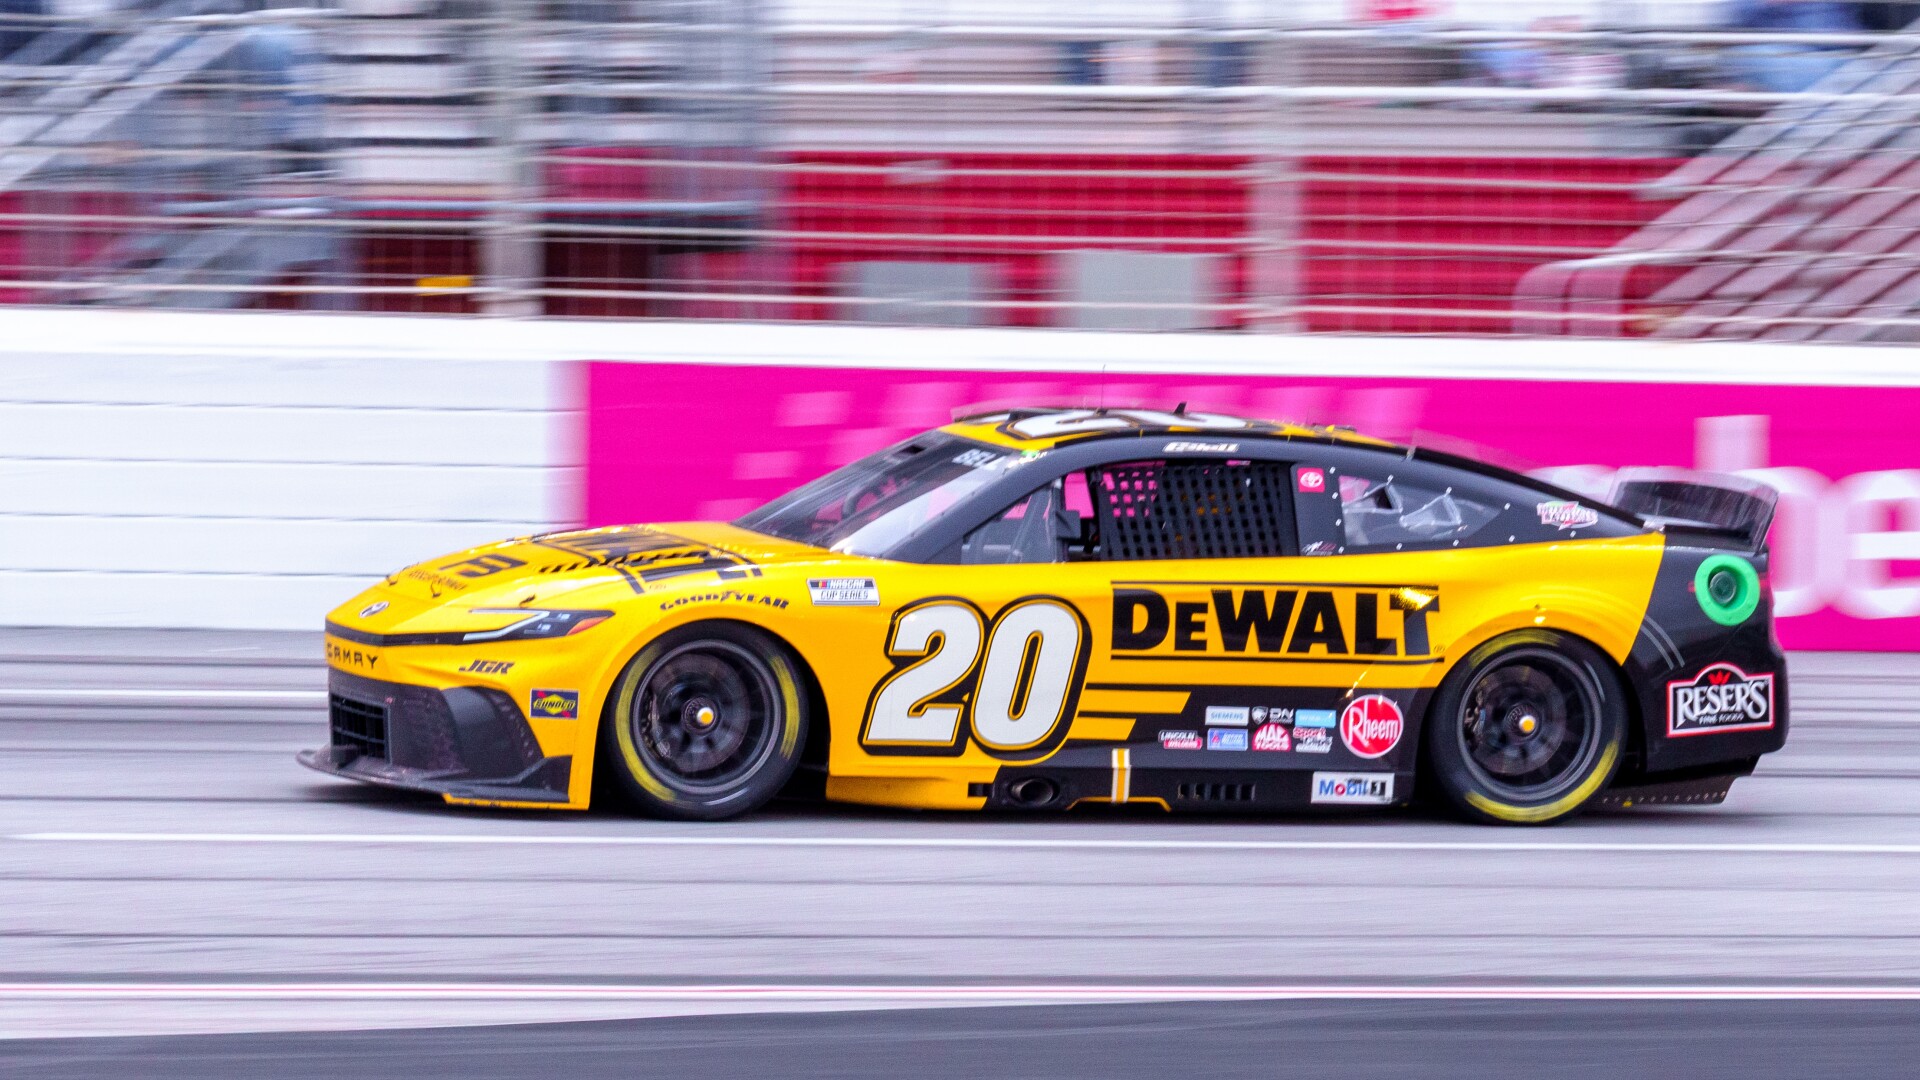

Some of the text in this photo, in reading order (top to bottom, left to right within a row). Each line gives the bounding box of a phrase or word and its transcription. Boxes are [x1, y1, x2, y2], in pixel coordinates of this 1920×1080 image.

[659, 590, 790, 611] GOODYEAR
[820, 589, 869, 600] CUP SERIES
[458, 659, 514, 675] JGR
[858, 596, 1092, 758] 20
[533, 698, 577, 711] SUNOCO
[1676, 680, 1768, 728] RESER'S
[1210, 711, 1245, 720] SIEMENS
[1347, 698, 1399, 747] Rheem
[1256, 723, 1289, 740] MAC
[1319, 779, 1368, 797] Mobil
